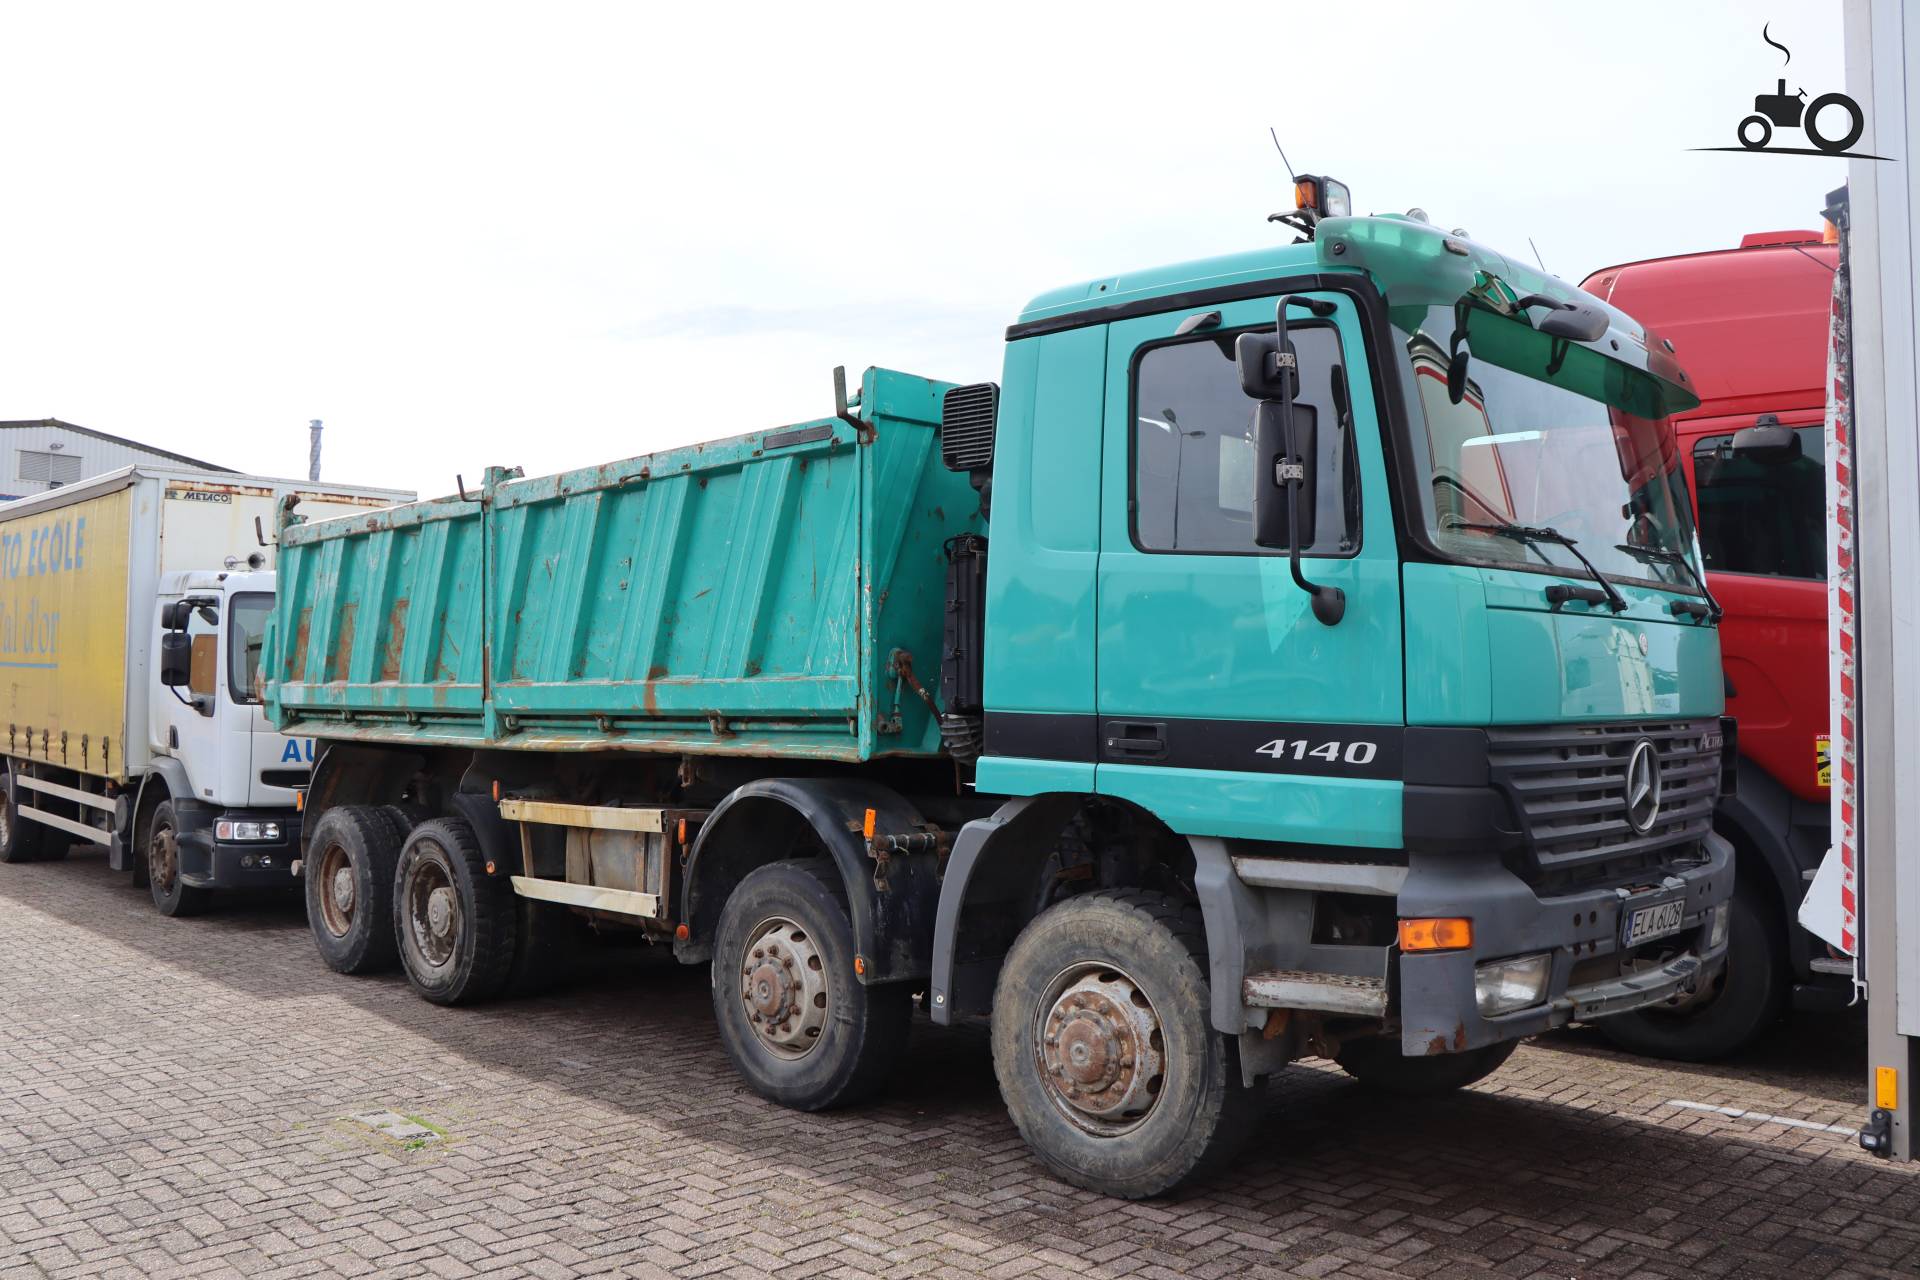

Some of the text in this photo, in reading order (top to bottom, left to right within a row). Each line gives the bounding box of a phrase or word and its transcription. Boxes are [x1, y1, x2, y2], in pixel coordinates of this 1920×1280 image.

[184, 492, 228, 502] METACO
[1, 517, 85, 578] TO ECOLE
[281, 739, 315, 763] AU
[1255, 739, 1377, 764] 4140
[1632, 909, 1655, 938] ELA
